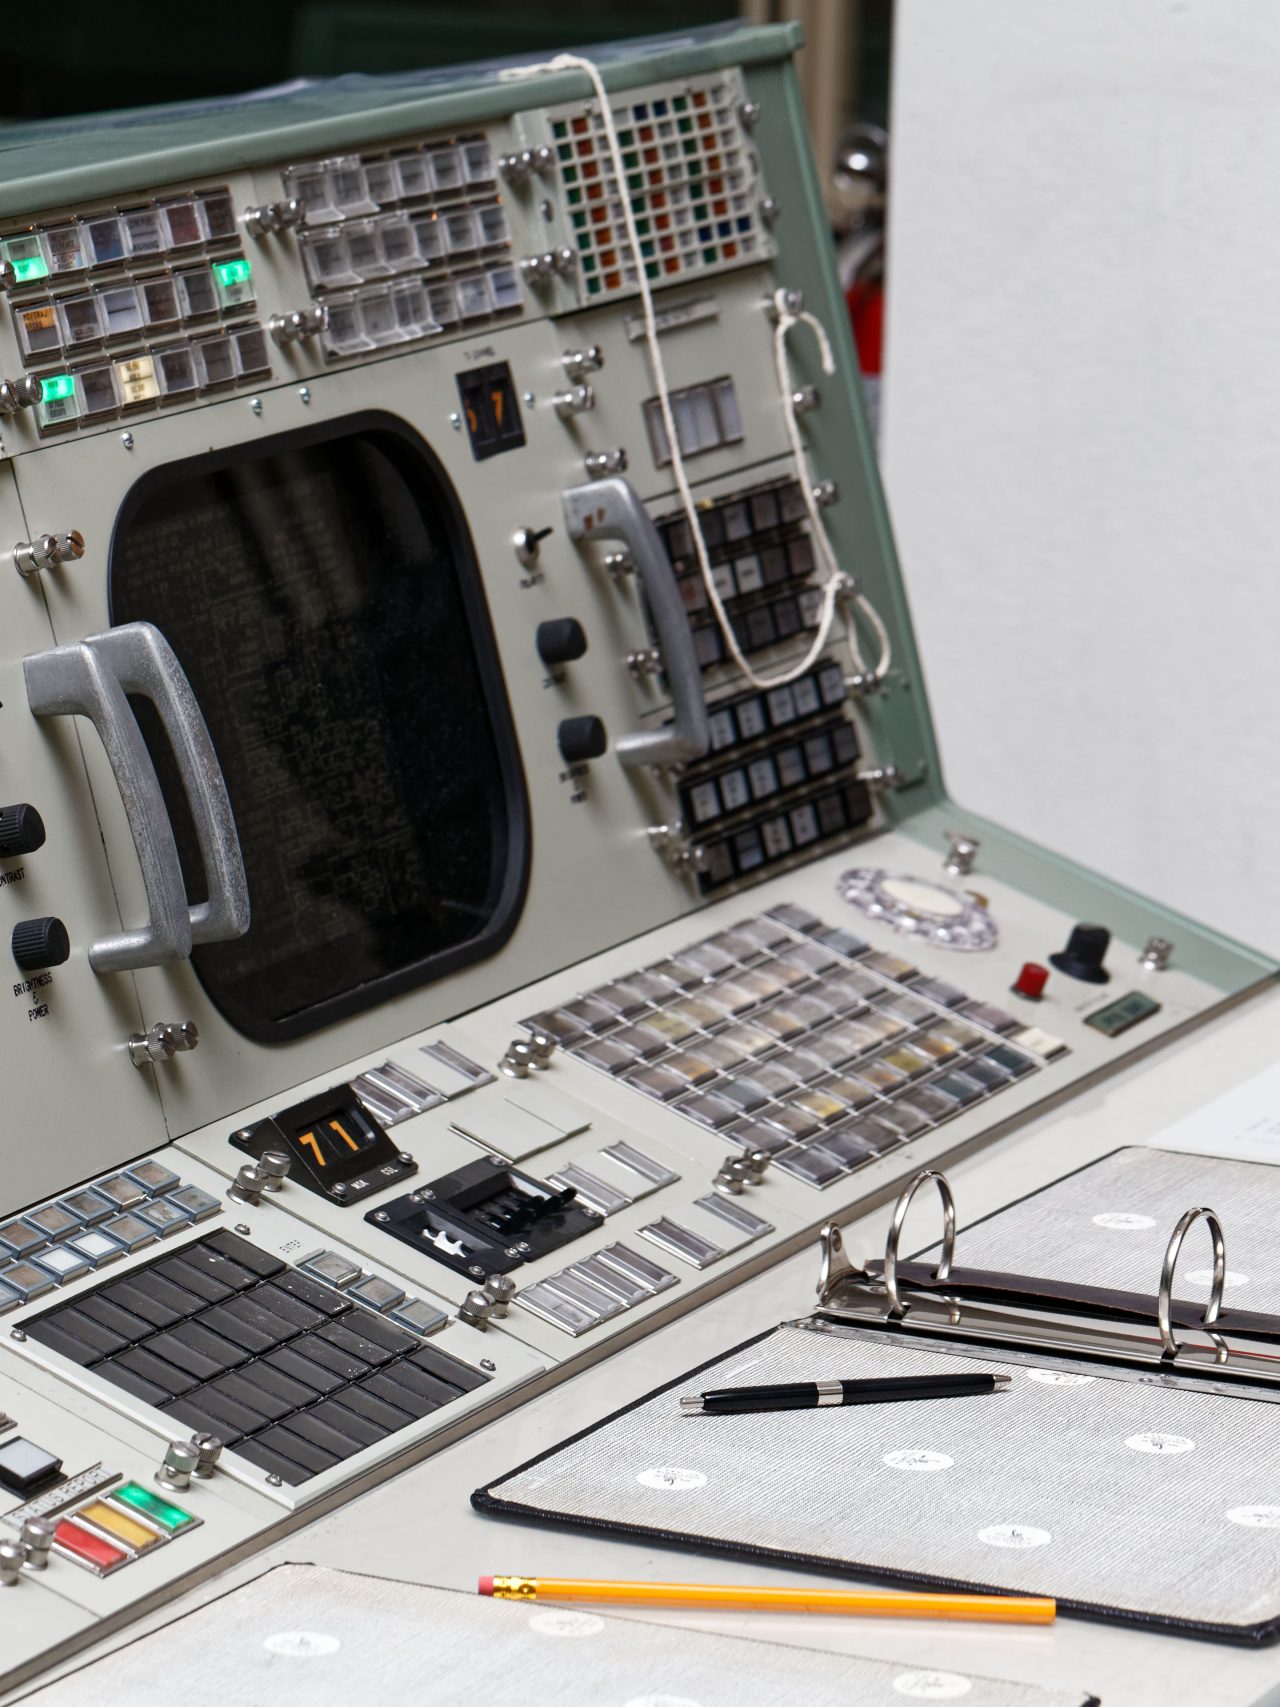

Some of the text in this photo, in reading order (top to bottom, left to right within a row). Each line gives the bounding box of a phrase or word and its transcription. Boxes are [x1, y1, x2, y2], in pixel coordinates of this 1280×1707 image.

[13, 974, 53, 998] BRIGHTNESS
[28, 1005, 50, 1022] POWER
[298, 1120, 360, 1167] 71
[11, 1465, 111, 1522] STATUS REPORT
